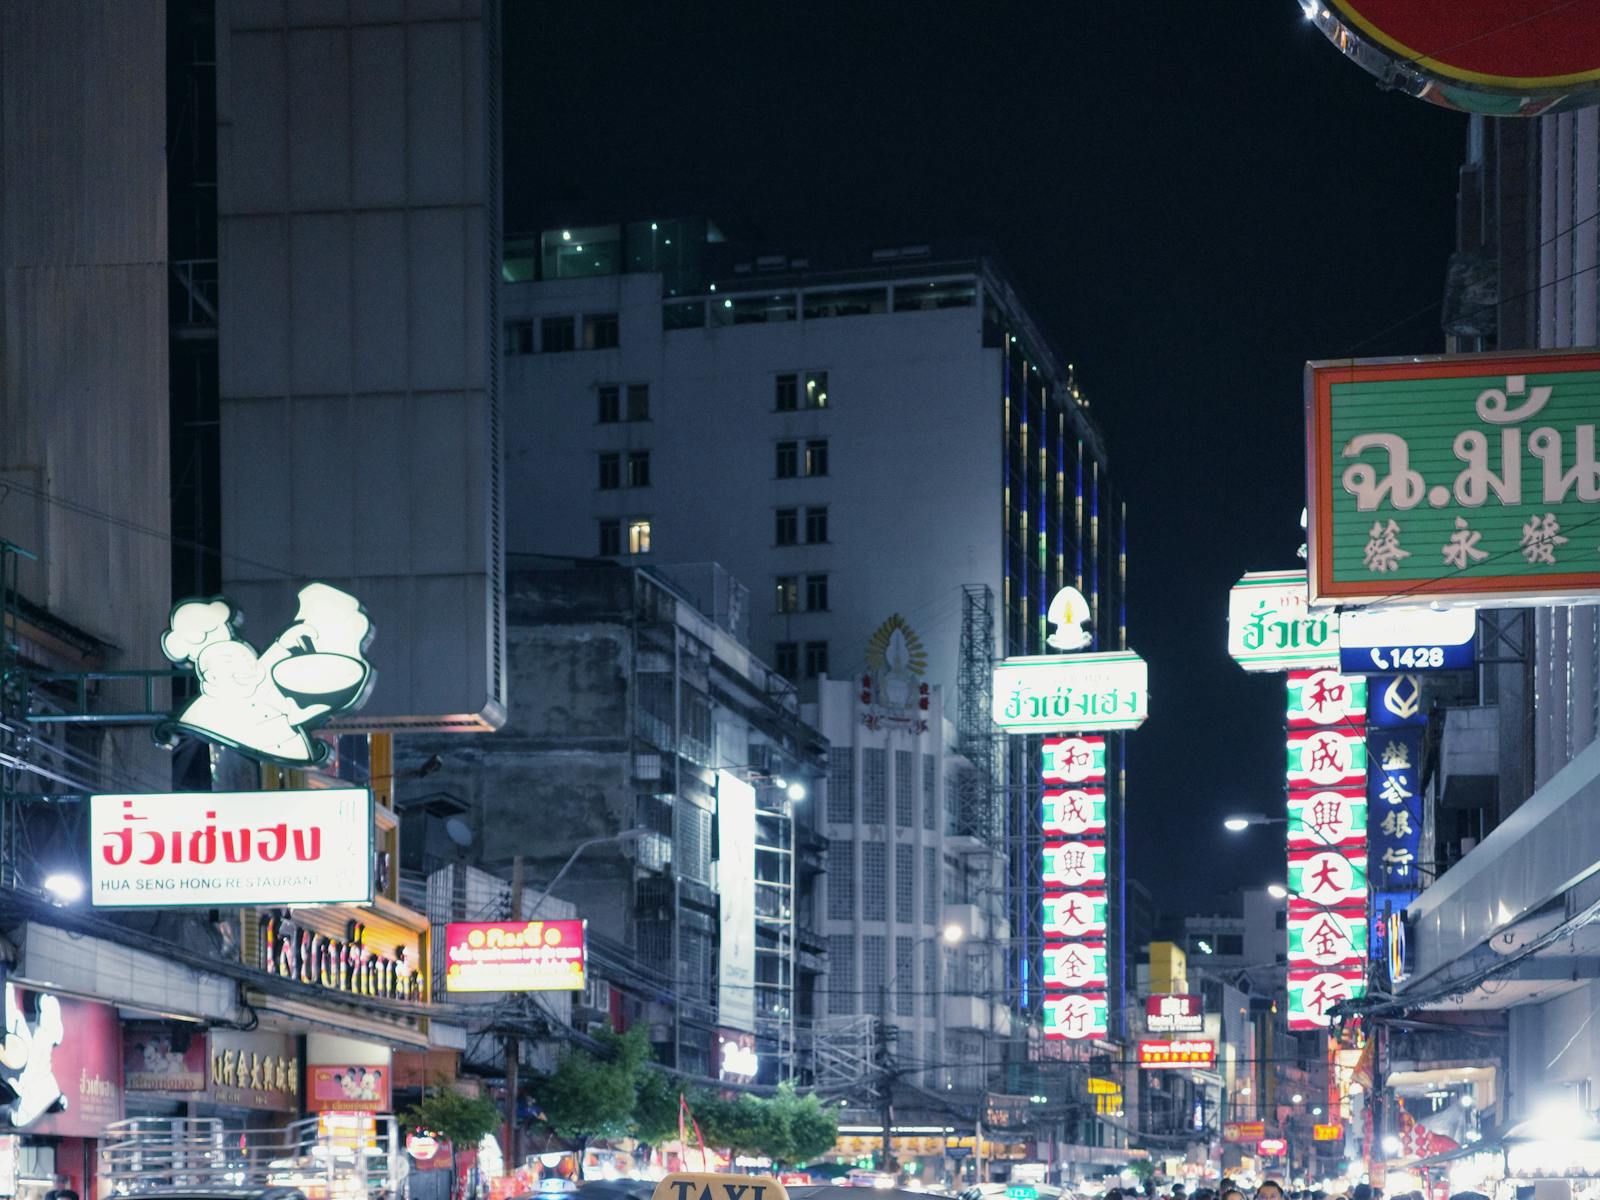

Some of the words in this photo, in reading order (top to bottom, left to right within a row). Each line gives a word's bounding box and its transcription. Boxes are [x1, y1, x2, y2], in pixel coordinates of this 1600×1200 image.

[1363, 512, 1600, 573] 蔡永發
[1390, 647, 1444, 668] 1428
[102, 800, 322, 866] ฮั่วเซ่งฮง
[100, 878, 131, 891] HUA
[135, 878, 176, 890] SENG
[180, 877, 222, 889] HONG
[1061, 745, 1090, 1032] 和成興大金行
